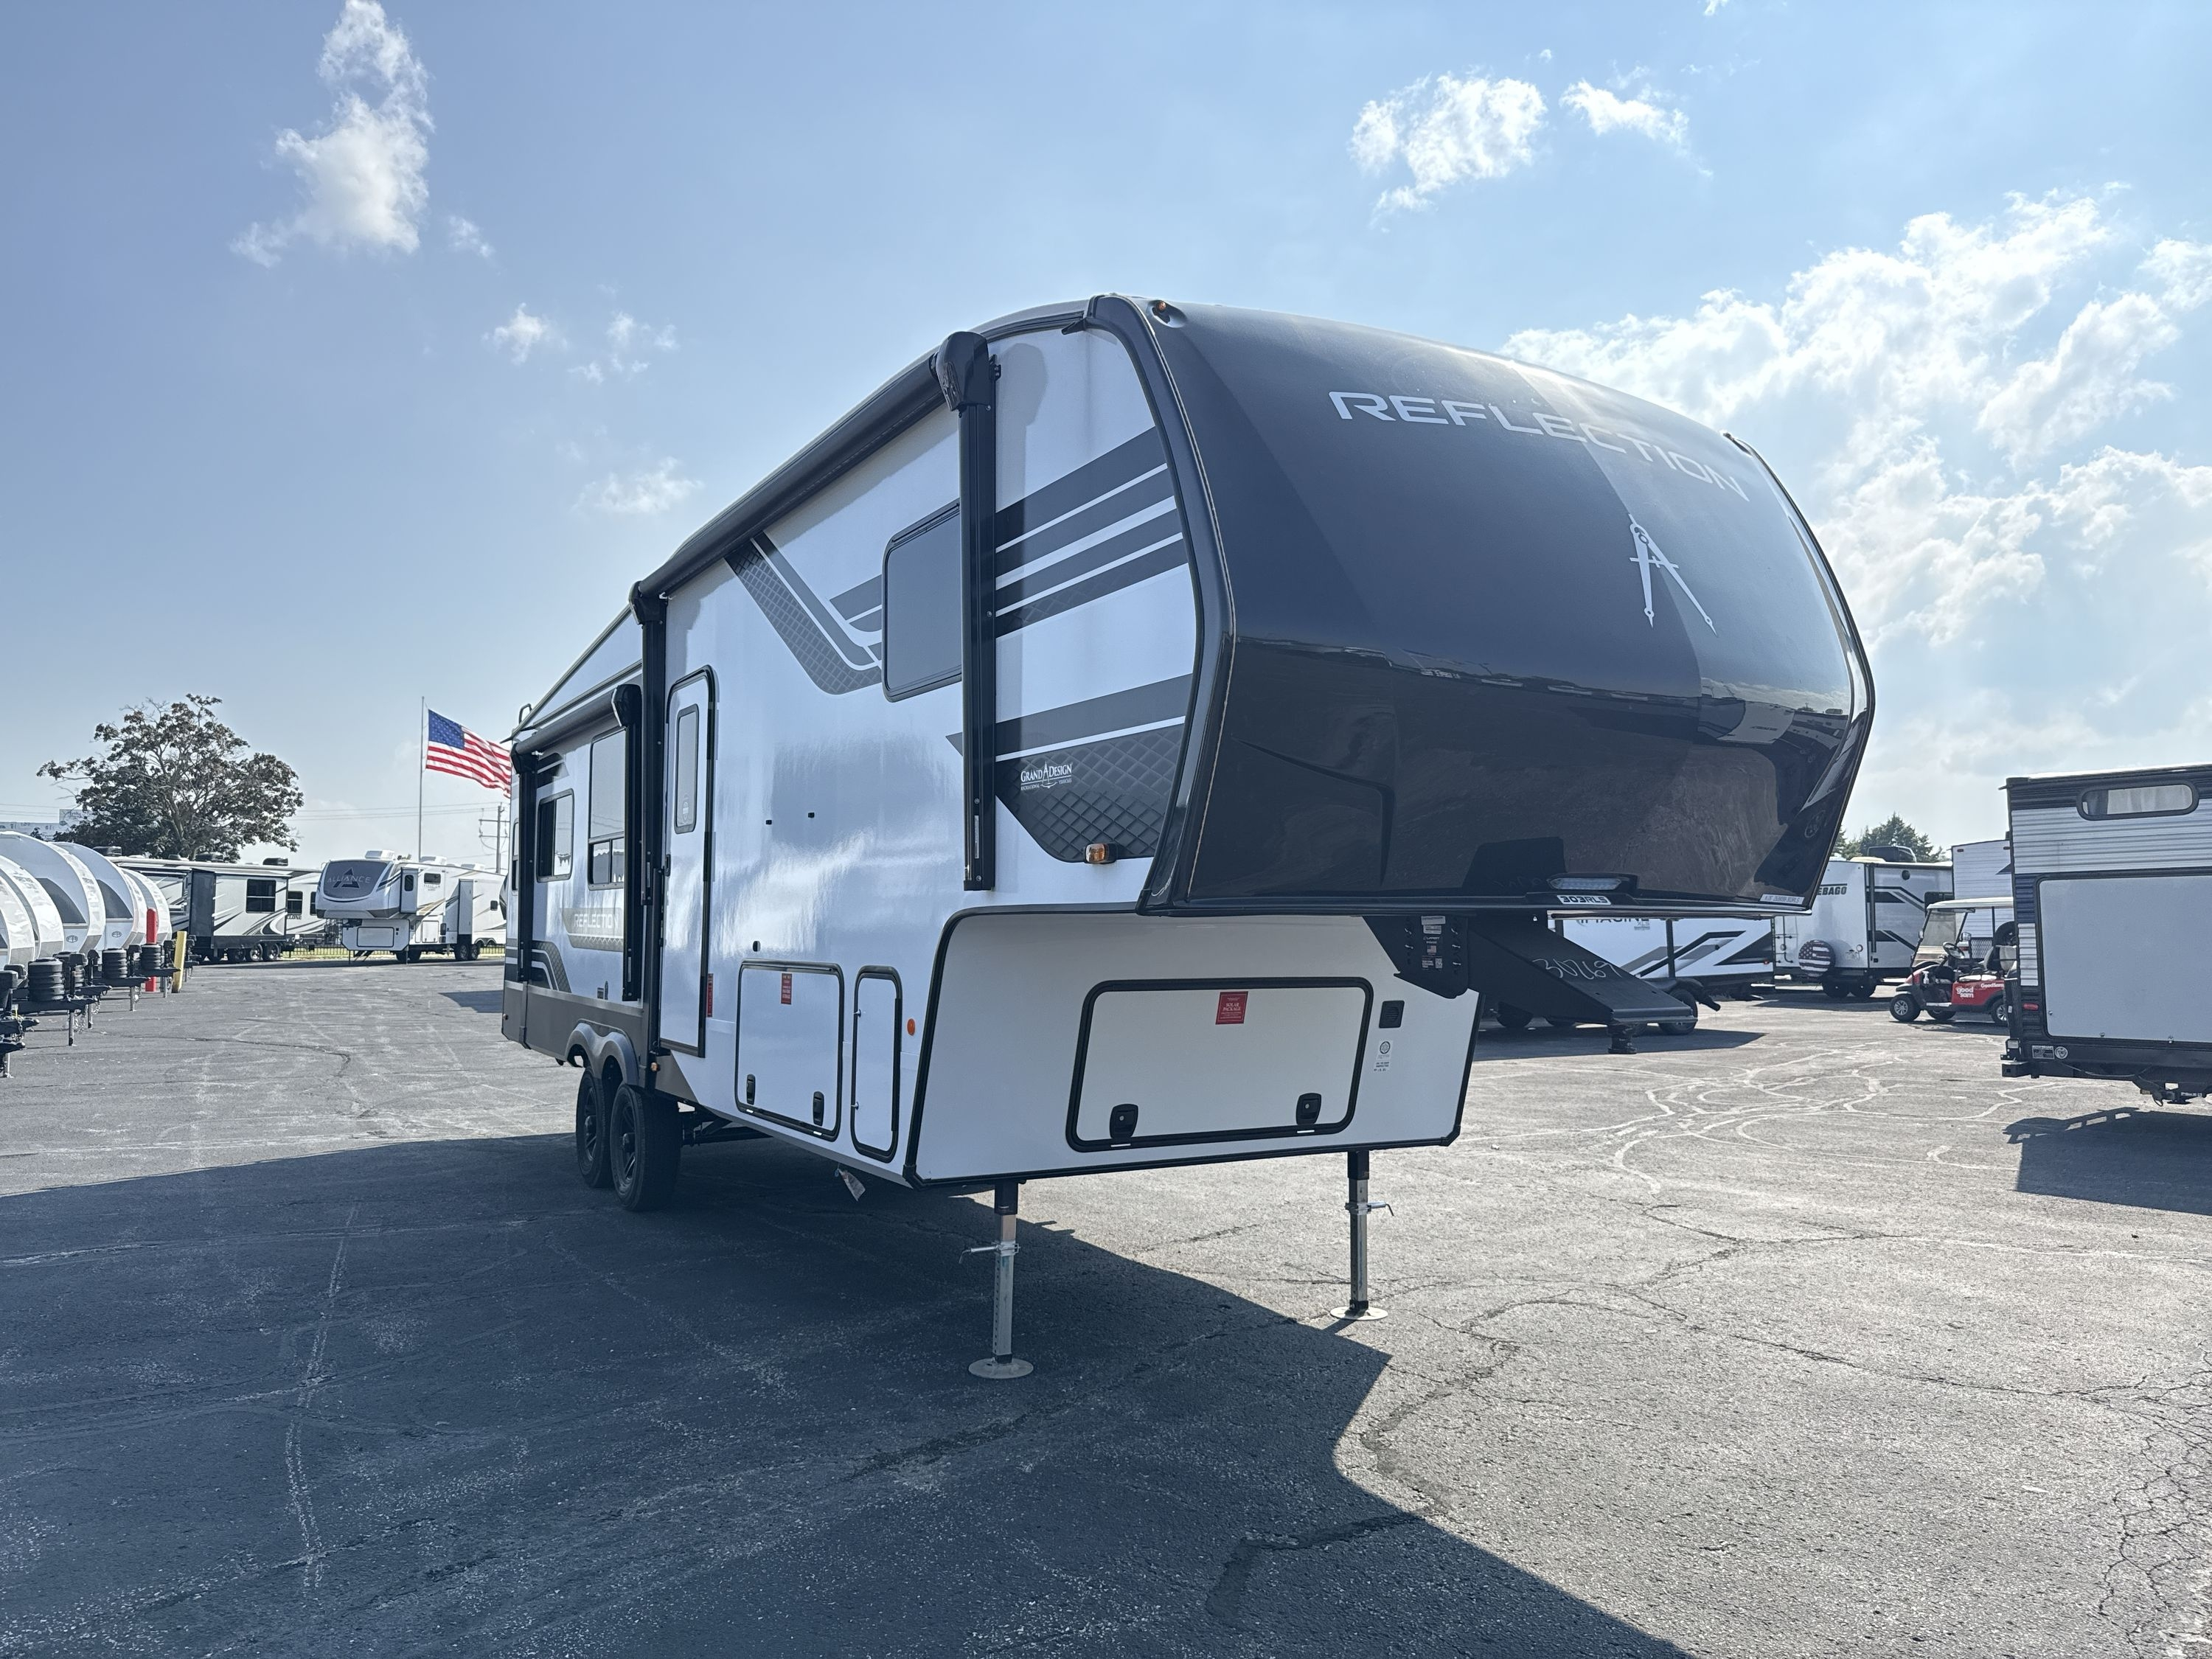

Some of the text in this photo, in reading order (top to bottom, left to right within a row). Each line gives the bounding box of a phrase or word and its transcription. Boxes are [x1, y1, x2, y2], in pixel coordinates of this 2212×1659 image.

[1328, 391, 1750, 501] REFLECTION
[1020, 764, 1072, 782] GRAND DESIGN
[327, 875, 371, 883] ALLIANCE
[574, 913, 619, 929] REFLECTION
[1956, 986, 1974, 995] good
